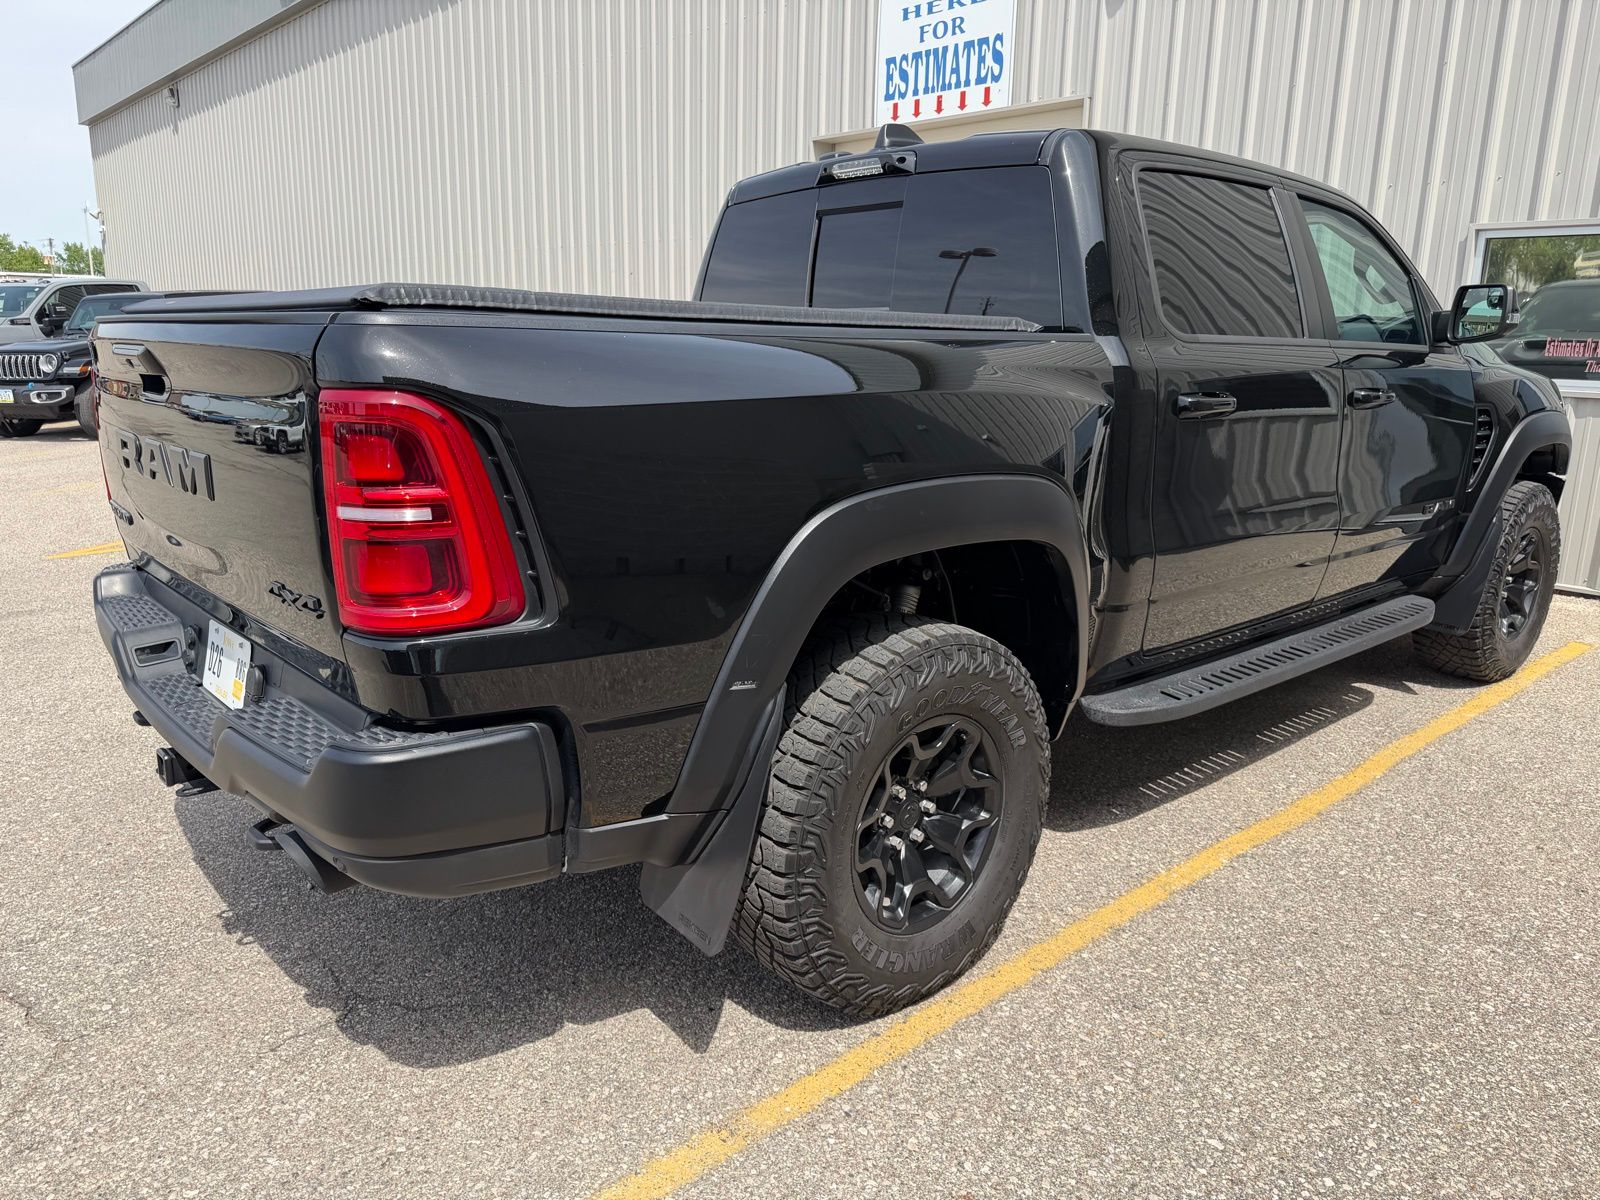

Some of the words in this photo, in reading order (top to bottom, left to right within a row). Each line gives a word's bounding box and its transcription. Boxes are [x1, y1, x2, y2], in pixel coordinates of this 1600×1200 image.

[902, 0, 988, 21] HER
[919, 16, 966, 43] FOR
[884, 32, 1004, 102] ESTIMATES
[1545, 337, 1585, 357] Estimates
[117, 428, 215, 501] RAM
[897, 682, 1027, 751] GOODYEAR
[852, 919, 977, 973] WRANGLER
